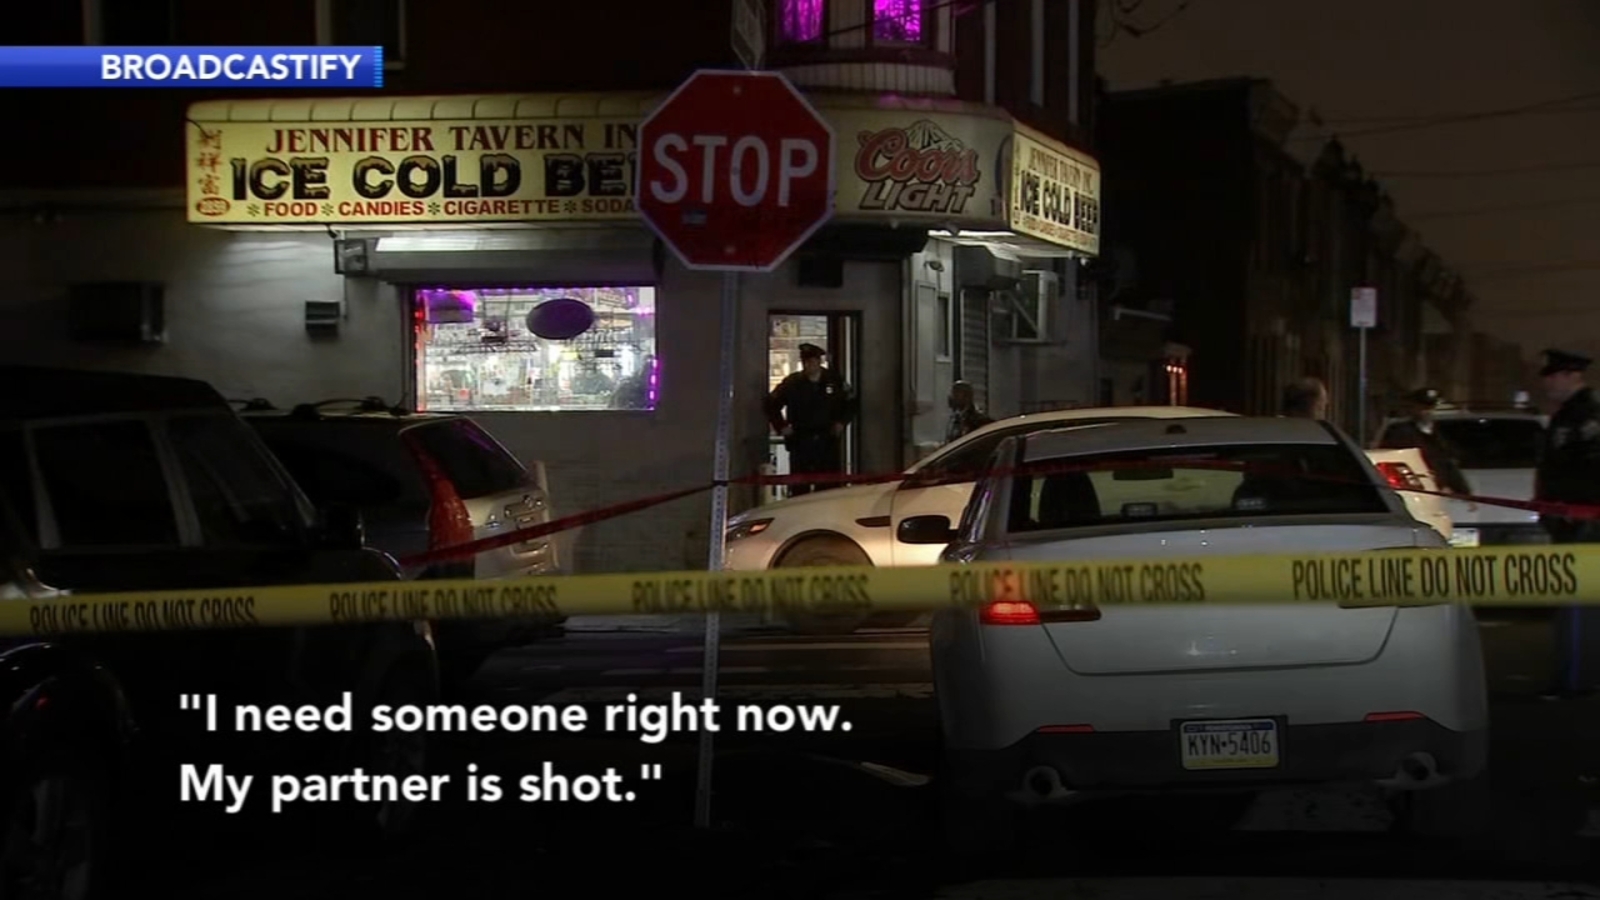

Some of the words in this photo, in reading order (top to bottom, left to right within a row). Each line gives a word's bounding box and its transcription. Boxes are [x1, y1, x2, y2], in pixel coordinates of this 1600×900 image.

[266, 127, 435, 153] JENNIFER
[449, 122, 585, 151] TAVERN
[603, 122, 638, 150] IN
[856, 127, 980, 185] Coors
[230, 155, 330, 200] ICE
[353, 153, 520, 199] COLD
[543, 152, 638, 197] BE
[650, 133, 819, 207] STOP
[265, 201, 318, 217] FOOD
[338, 200, 424, 216] CANDIES
[444, 199, 560, 215] CIGARETTE
[859, 181, 976, 215] LIGHT
[1020, 170, 1040, 216] ICE
[1043, 179, 1072, 226] COLD
[951, 569, 1013, 600] POLICE
[1018, 567, 1060, 599] LINE
[1066, 565, 1090, 600] DO
[1098, 564, 1134, 600] NOT
[1139, 562, 1206, 601] CROSS
[1292, 559, 1361, 599] POLICE
[1369, 557, 1413, 598] LINE
[1420, 556, 1449, 597] DO
[1455, 555, 1497, 596] NOT
[1503, 553, 1577, 595] CROSS
[30, 604, 87, 634] POLICE
[93, 602, 129, 631] LINE
[134, 600, 158, 630] DO
[163, 599, 195, 628] NOT
[201, 596, 258, 626] CROSS
[330, 591, 387, 621] POLICE
[392, 590, 429, 619] LINE
[434, 589, 459, 618] DO
[463, 588, 497, 617] NOT
[501, 585, 559, 613] CROSS
